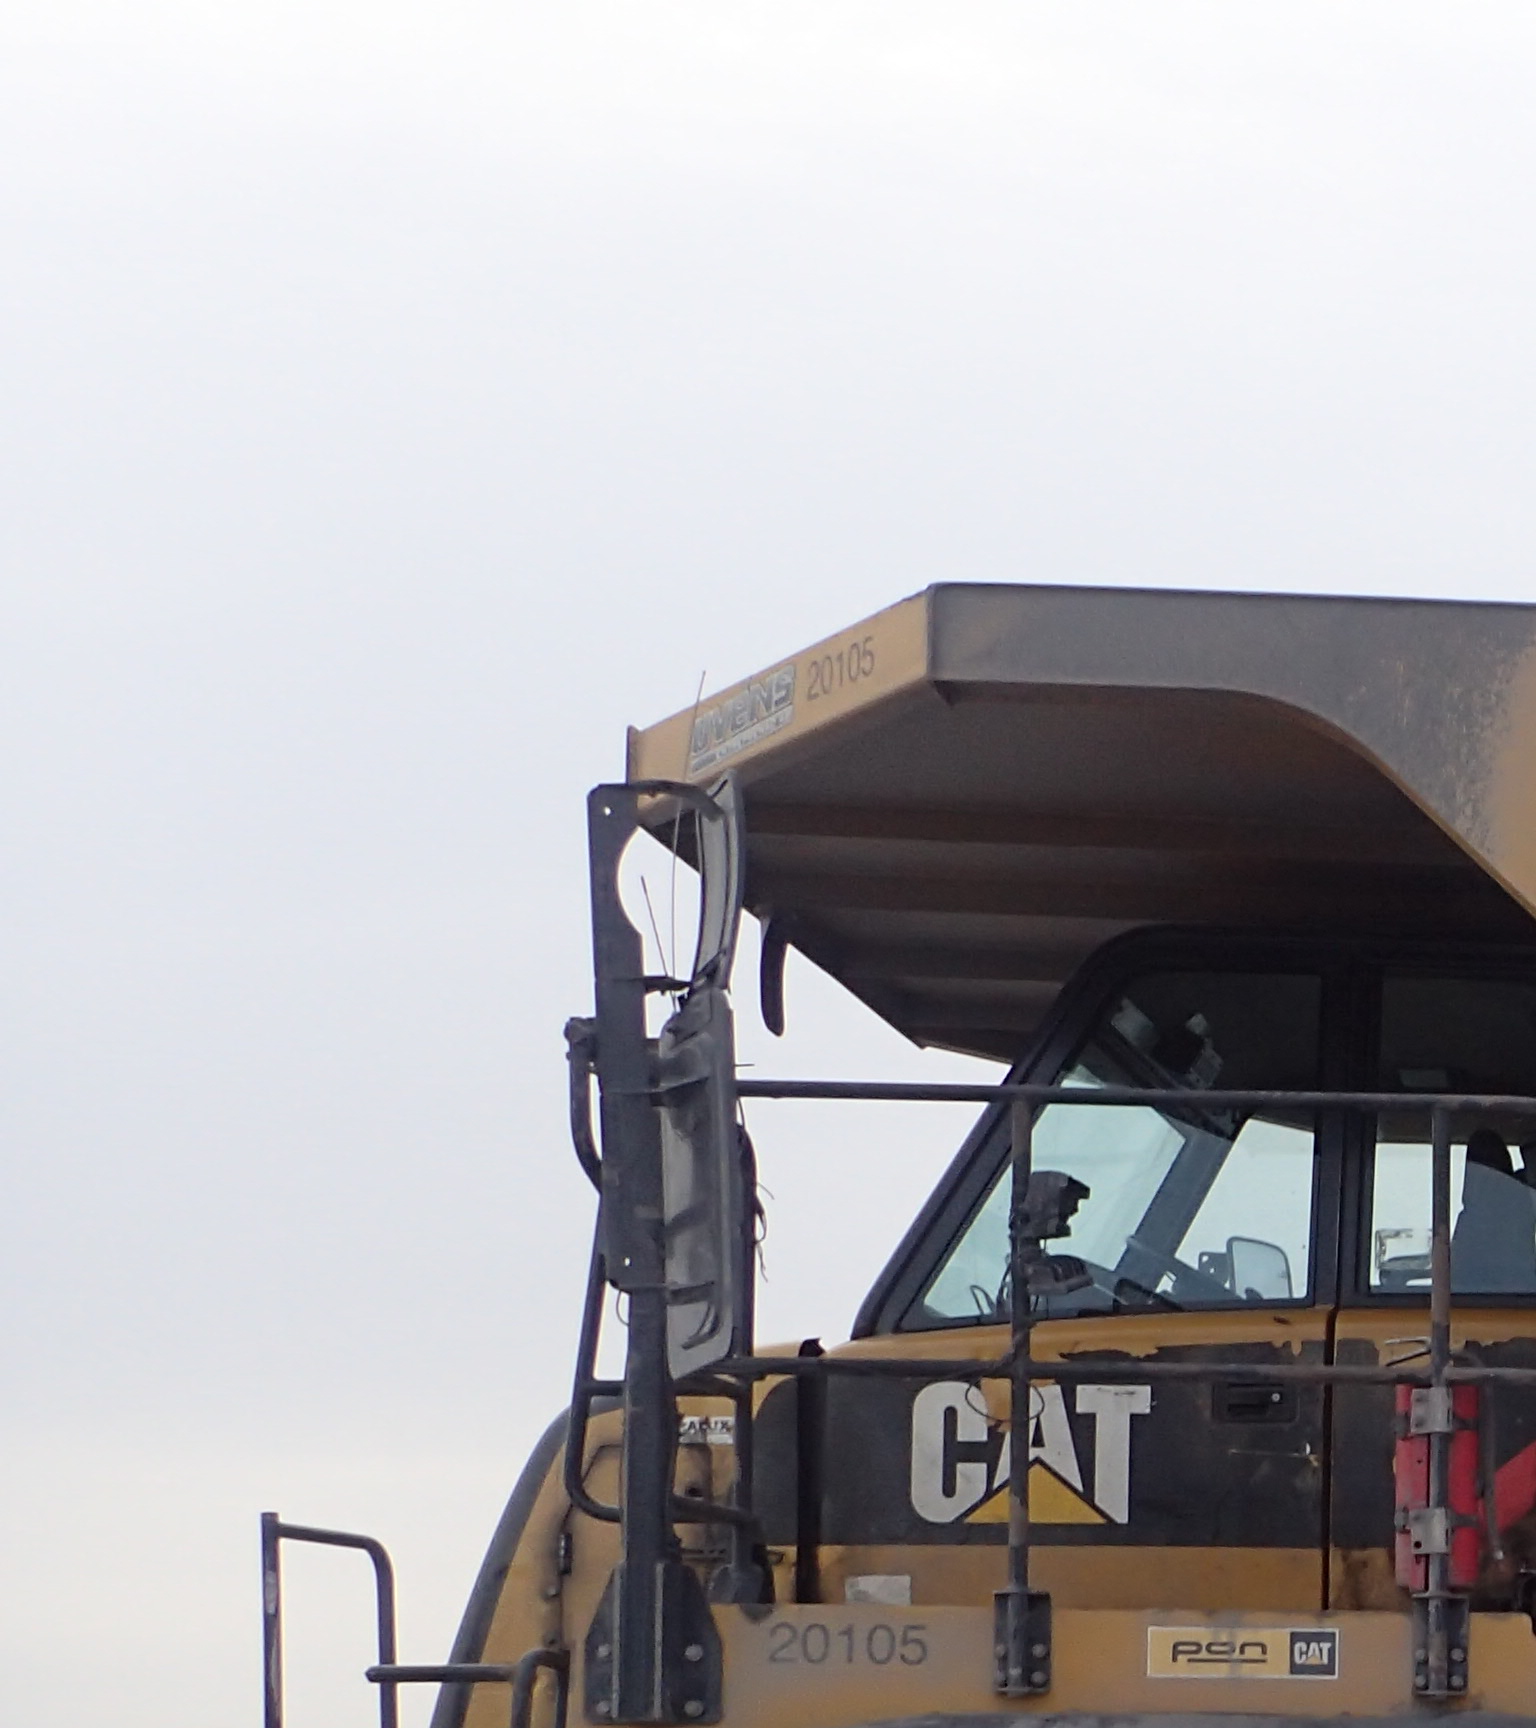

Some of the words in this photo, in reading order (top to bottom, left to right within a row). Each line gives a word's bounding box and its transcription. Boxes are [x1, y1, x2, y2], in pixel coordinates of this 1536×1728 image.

[806, 636, 875, 701] 20105
[911, 1380, 1152, 1524] CAT
[768, 1621, 928, 1666] 20105
[1294, 1641, 1332, 1665] CAT
